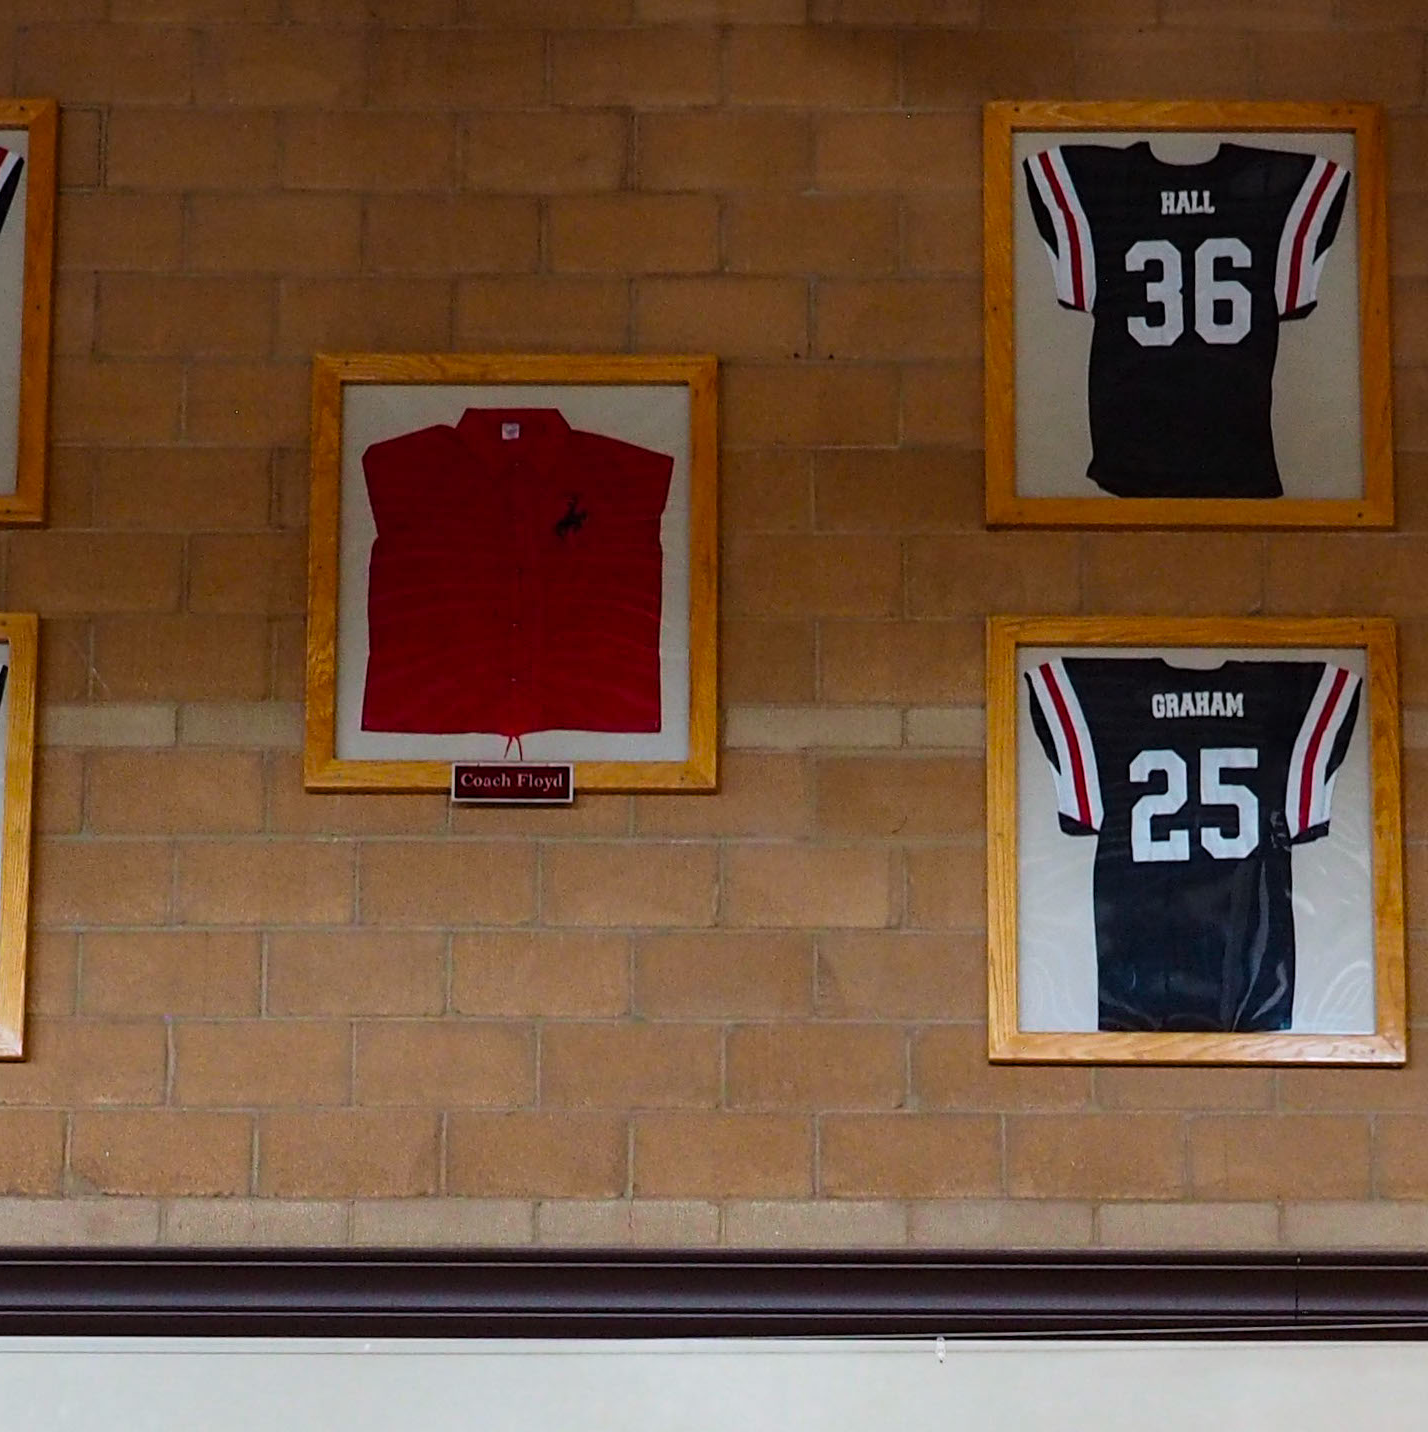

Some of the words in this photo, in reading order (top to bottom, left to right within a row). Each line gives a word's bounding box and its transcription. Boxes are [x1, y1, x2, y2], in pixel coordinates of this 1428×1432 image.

[1160, 190, 1216, 215] HALL
[1124, 237, 1252, 347] 36
[1151, 691, 1244, 719] GRAHAM
[460, 772, 510, 787] Coach
[517, 772, 564, 792] Floyd
[1129, 747, 1260, 863] 25
